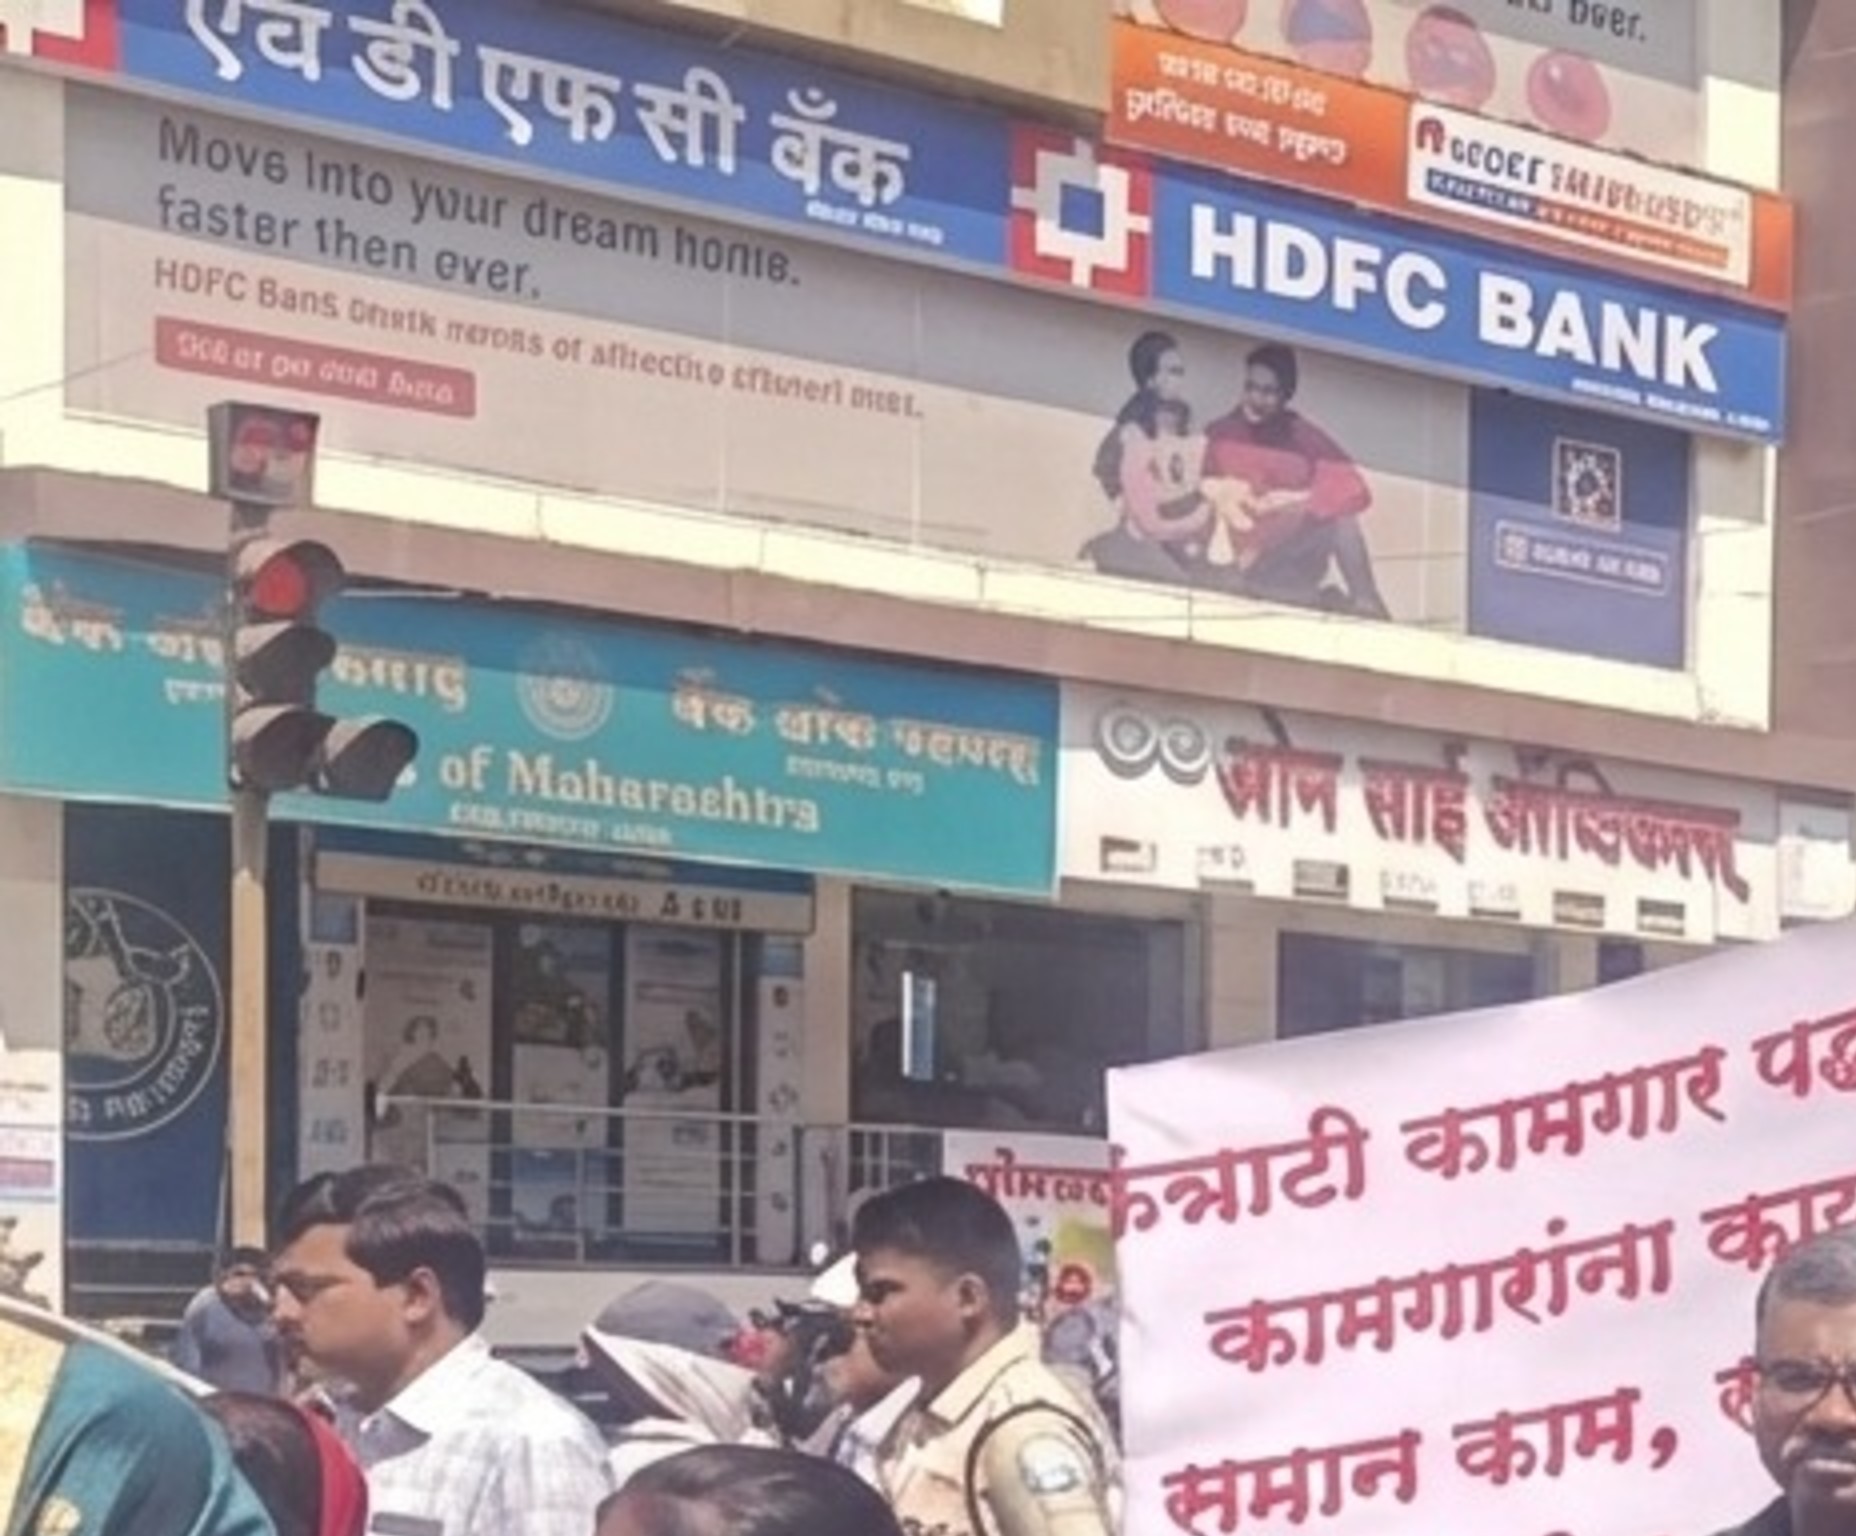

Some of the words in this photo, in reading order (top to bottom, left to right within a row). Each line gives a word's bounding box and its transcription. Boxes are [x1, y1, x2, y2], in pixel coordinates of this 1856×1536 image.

[633, 66, 746, 175] सी
[1190, 202, 1447, 331] HDFC
[1478, 269, 1718, 394] BANK
[438, 745, 492, 791] of
[1398, 1046, 1728, 1181] कामगार
[1452, 1387, 1679, 1486] काम,
